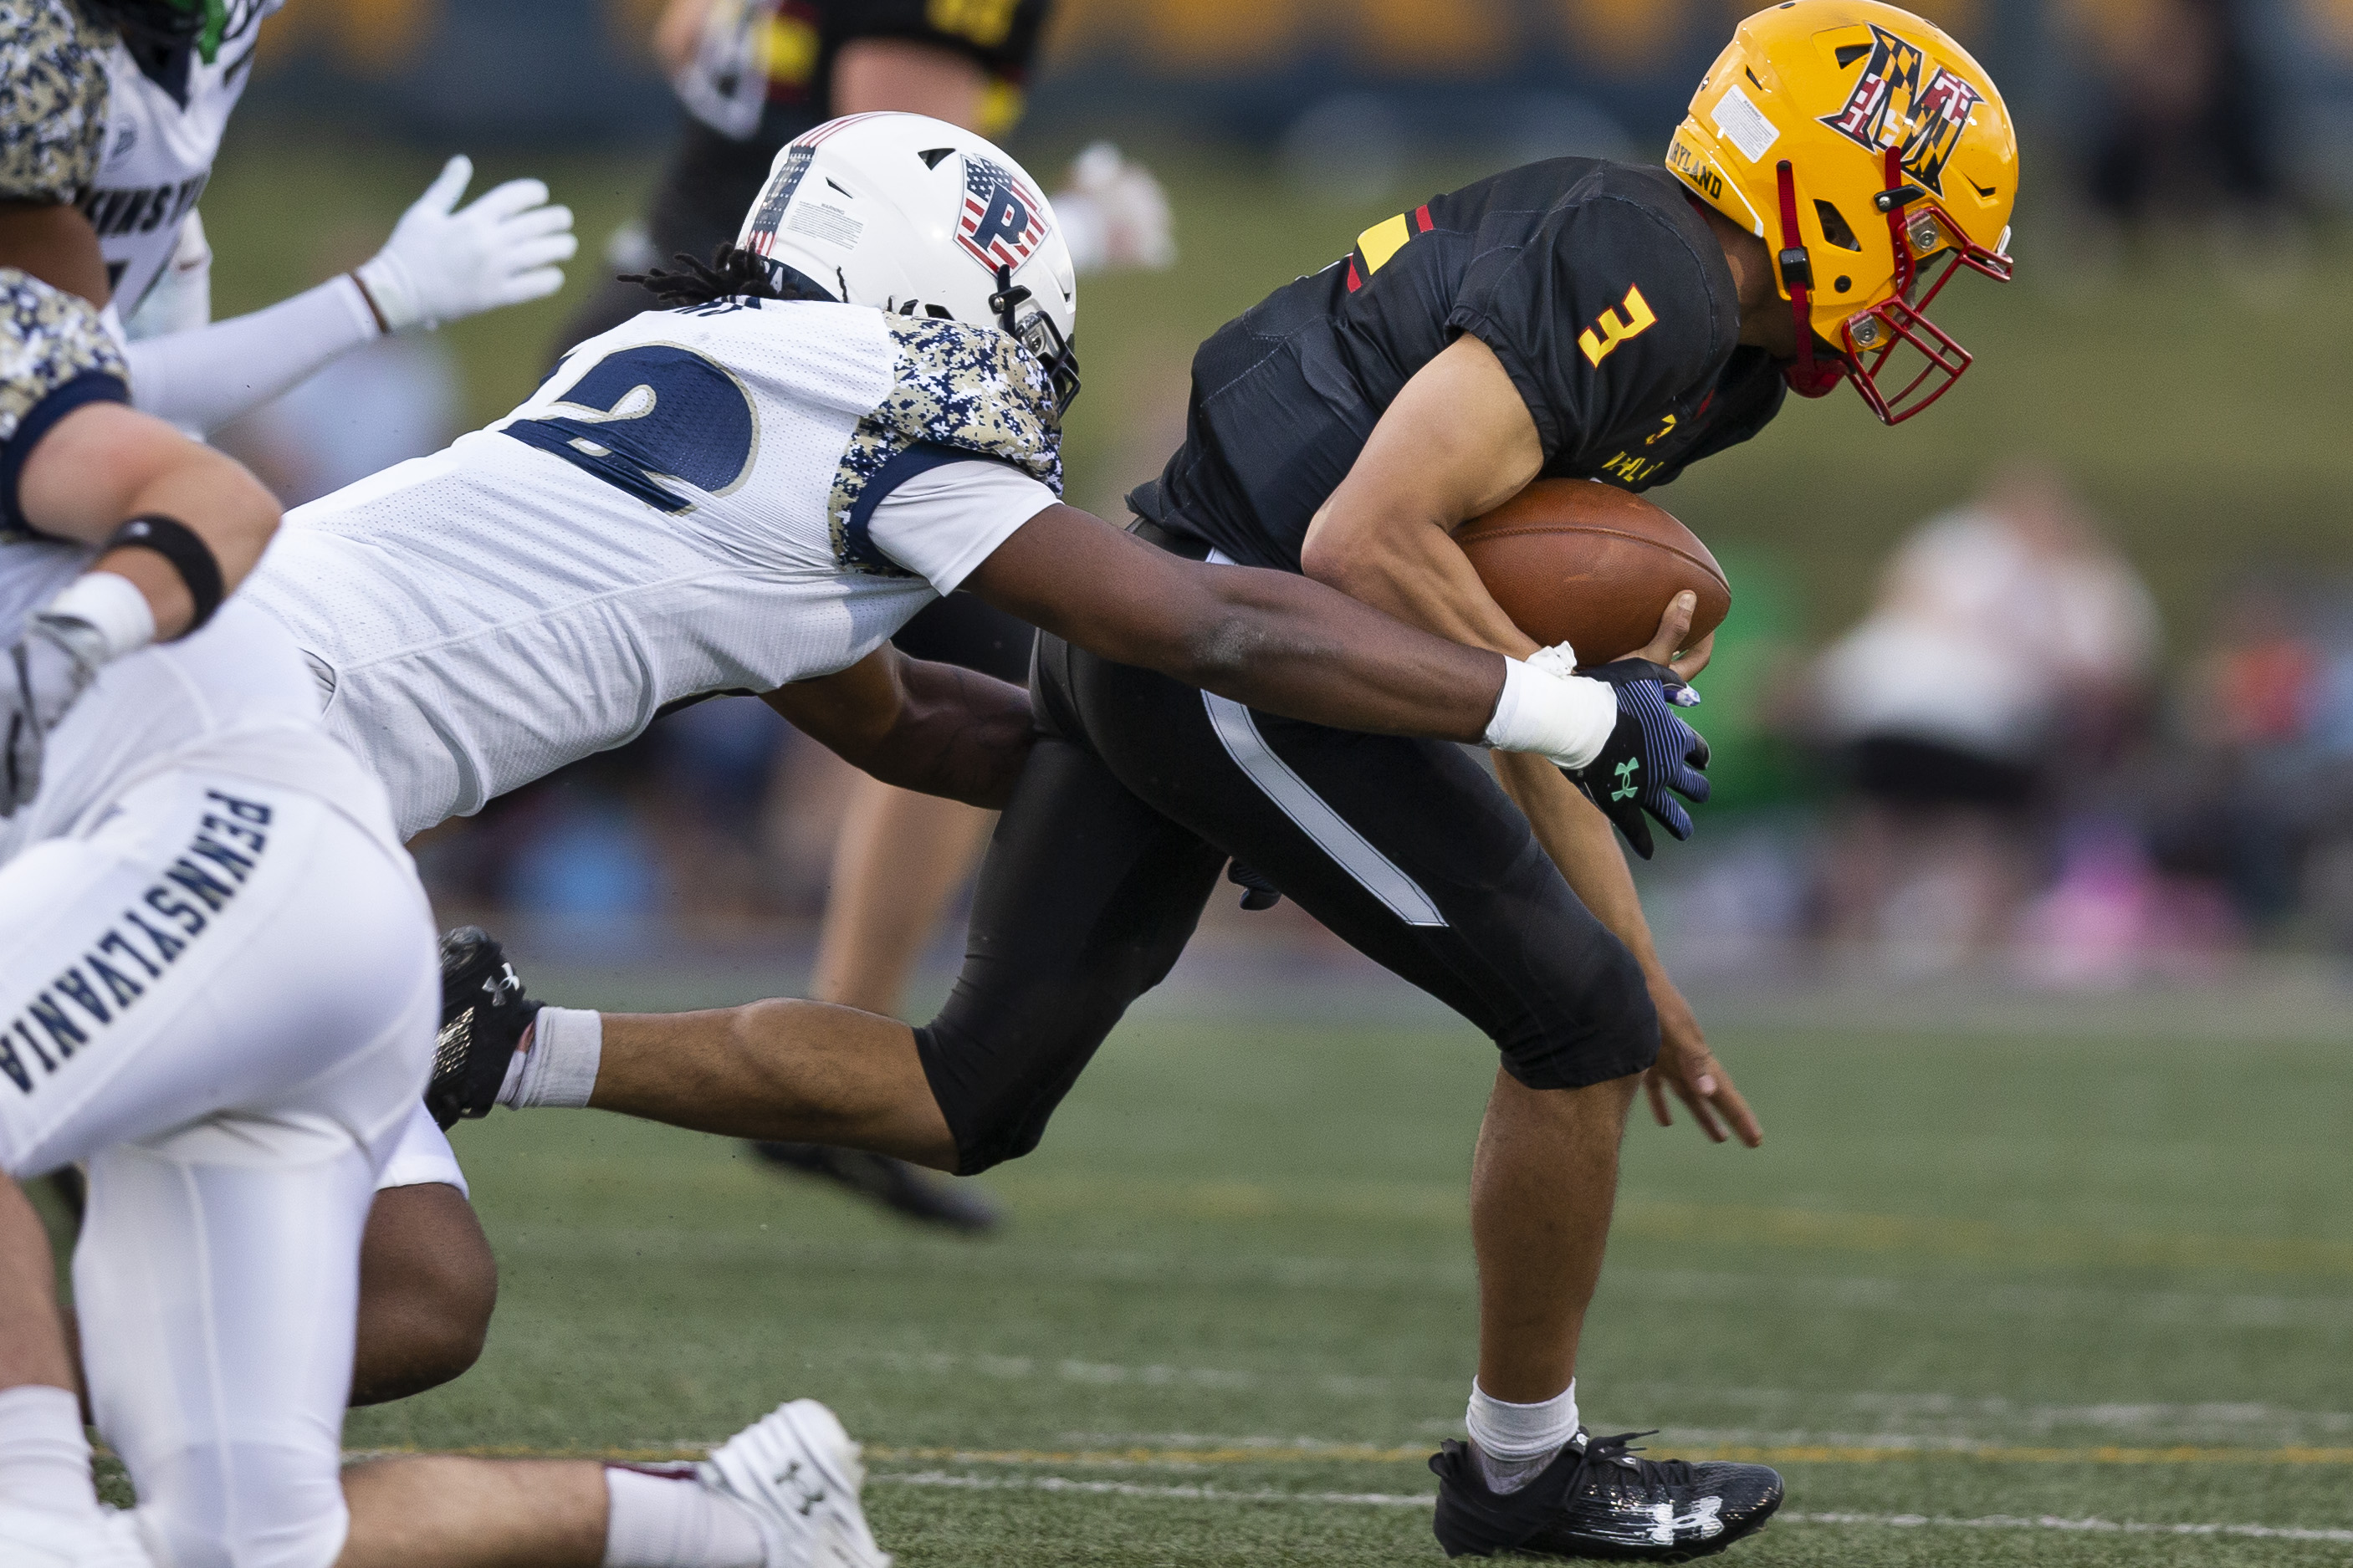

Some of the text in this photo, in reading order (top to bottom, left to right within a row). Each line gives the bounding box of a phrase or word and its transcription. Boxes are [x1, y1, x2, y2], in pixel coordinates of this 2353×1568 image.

[1814, 21, 1987, 200] M
[969, 177, 1029, 253] P
[1578, 282, 1658, 368] 3
[0, 789, 274, 1095] PENNSYLVANIA
